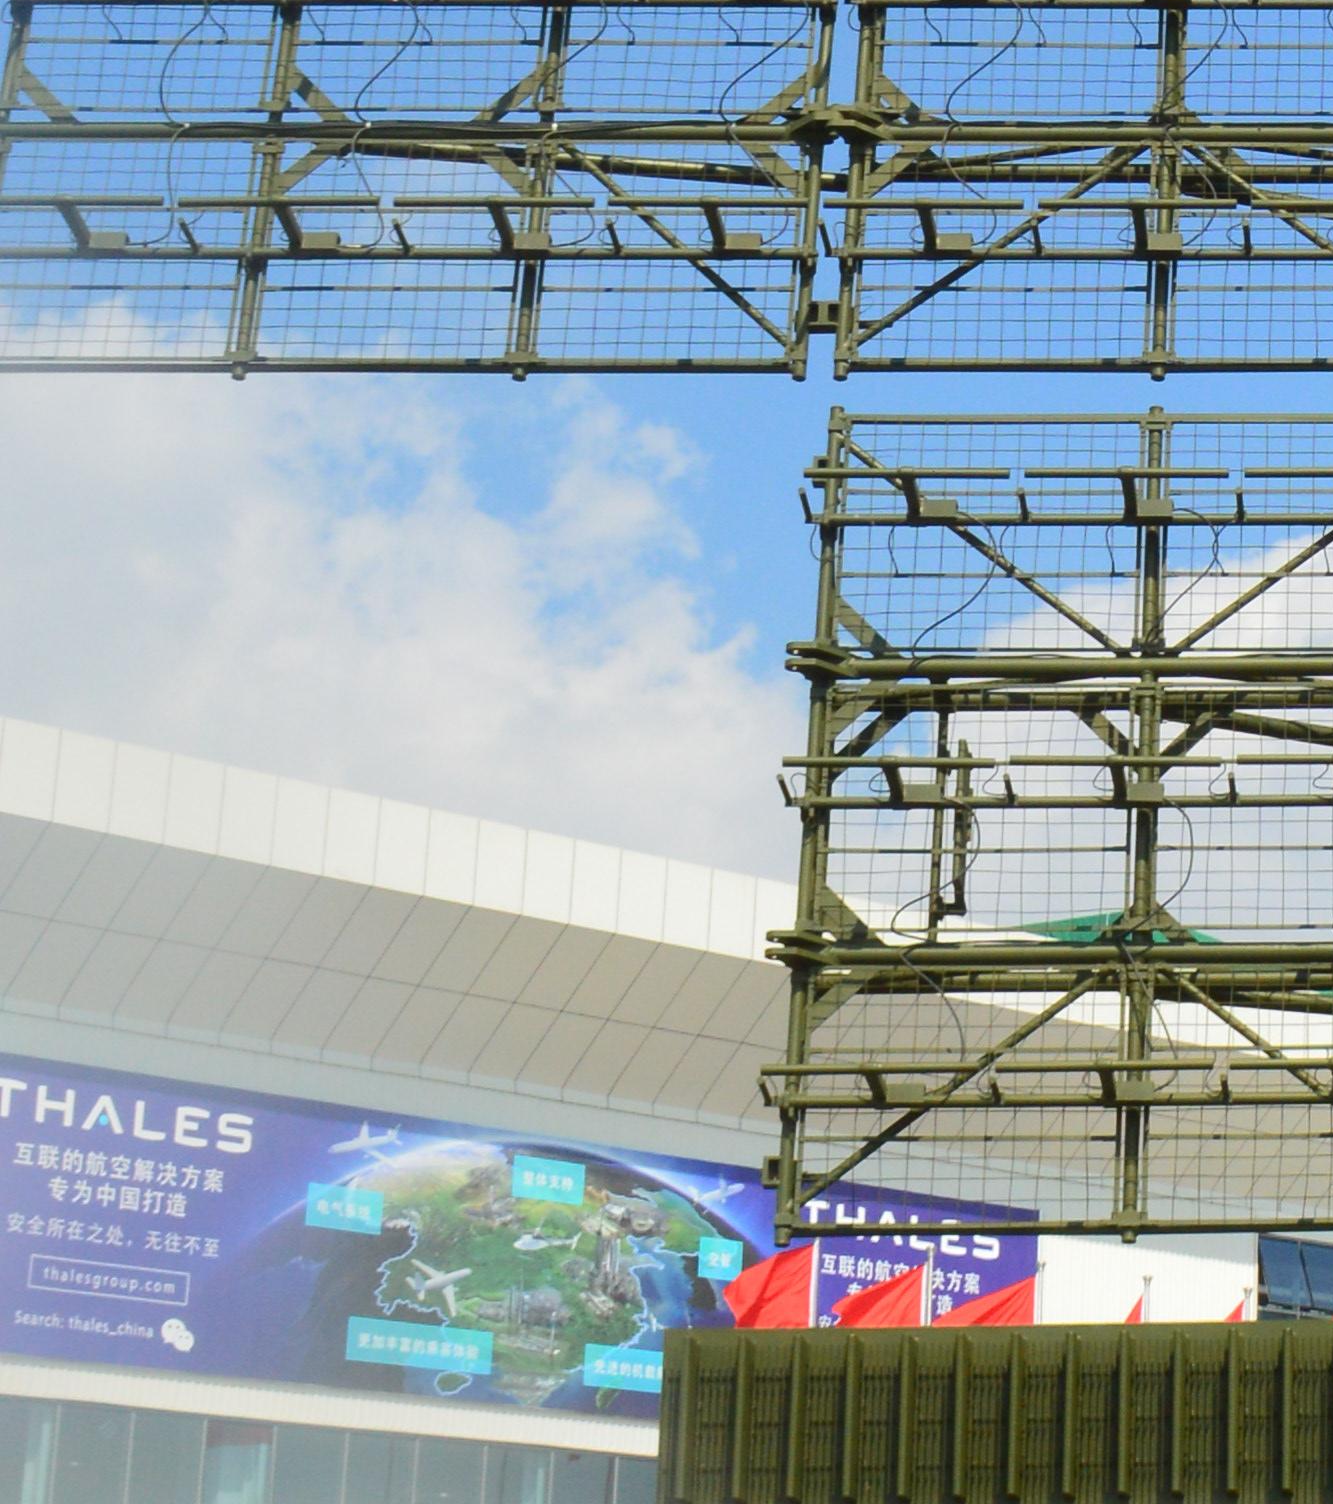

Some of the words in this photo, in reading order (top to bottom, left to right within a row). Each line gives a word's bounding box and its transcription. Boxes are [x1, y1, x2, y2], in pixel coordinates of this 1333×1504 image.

[0, 1077, 254, 1153] THALES
[13, 1142, 224, 1193] 互联的航空解决方案
[48, 1176, 188, 1218] 专为中国打造
[43, 1265, 176, 1295] thalesgroup.com
[821, 1253, 981, 1295] 互联的航空决方案
[14, 1310, 64, 1329] Search:
[68, 1316, 154, 1338] thales_china
